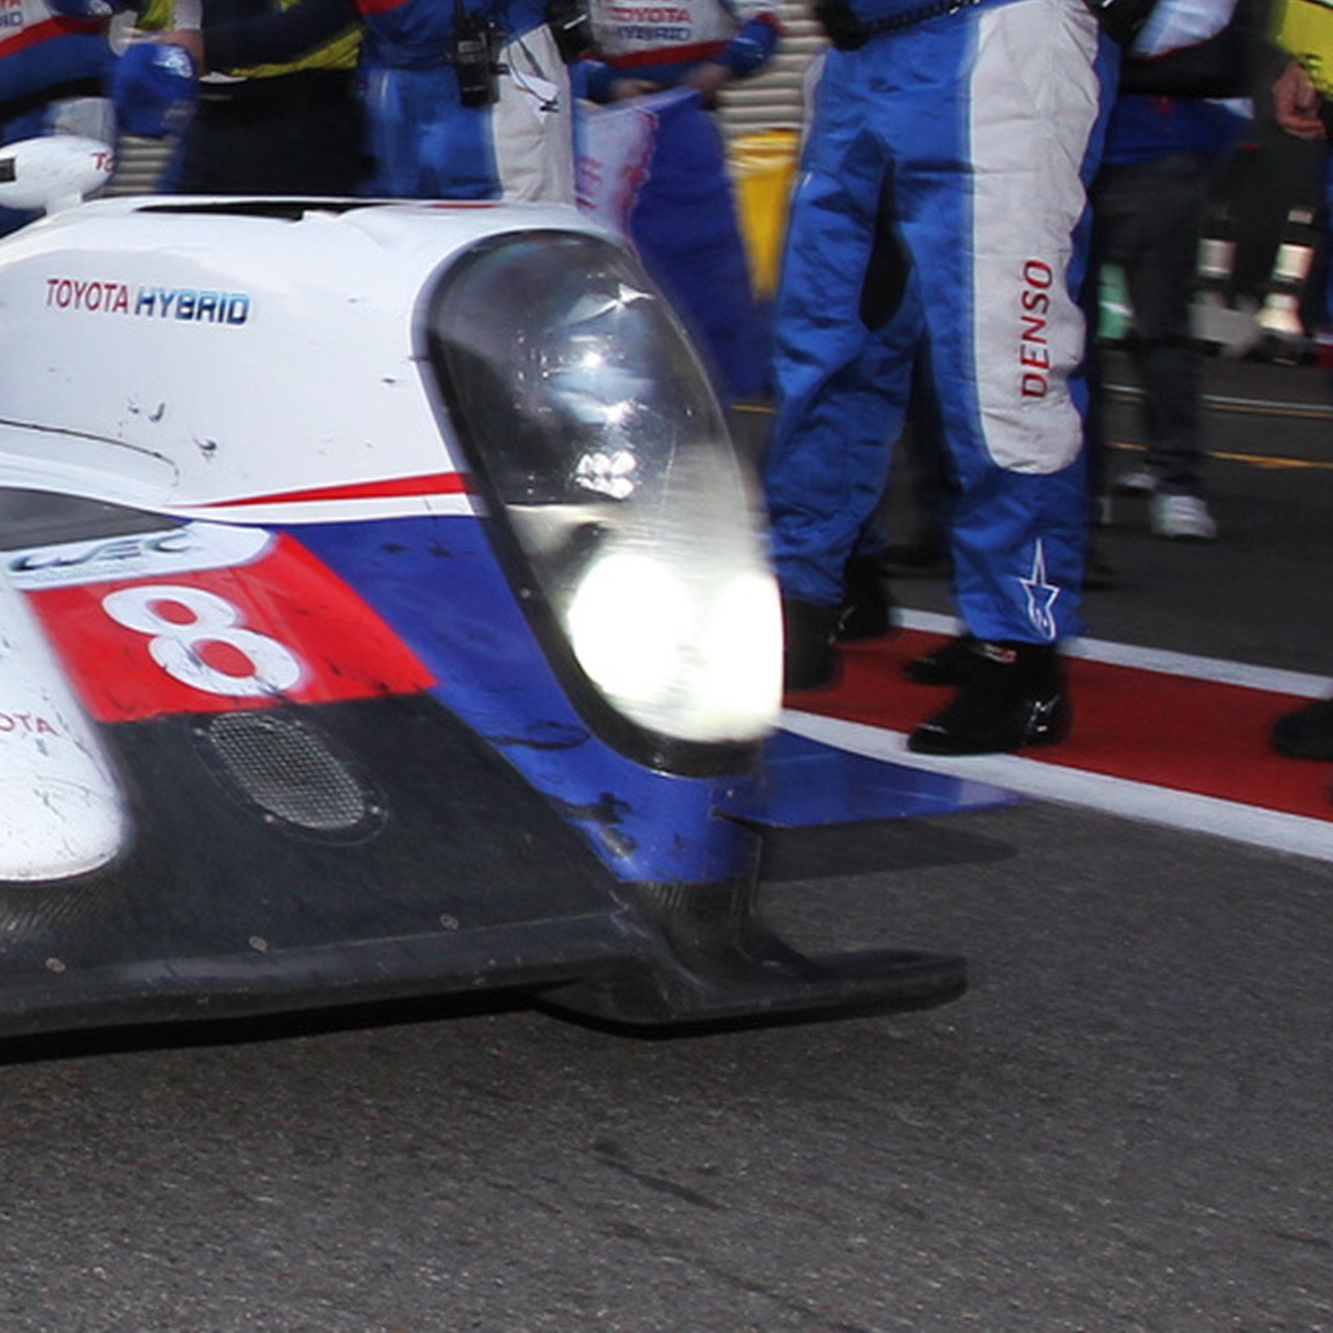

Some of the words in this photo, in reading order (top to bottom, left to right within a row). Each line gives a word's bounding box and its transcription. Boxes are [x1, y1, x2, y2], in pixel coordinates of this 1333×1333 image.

[46, 278, 129, 315] TOYOTA
[134, 286, 251, 325] HYBRID
[1019, 259, 1053, 398] DENSO
[101, 584, 302, 698] 8
